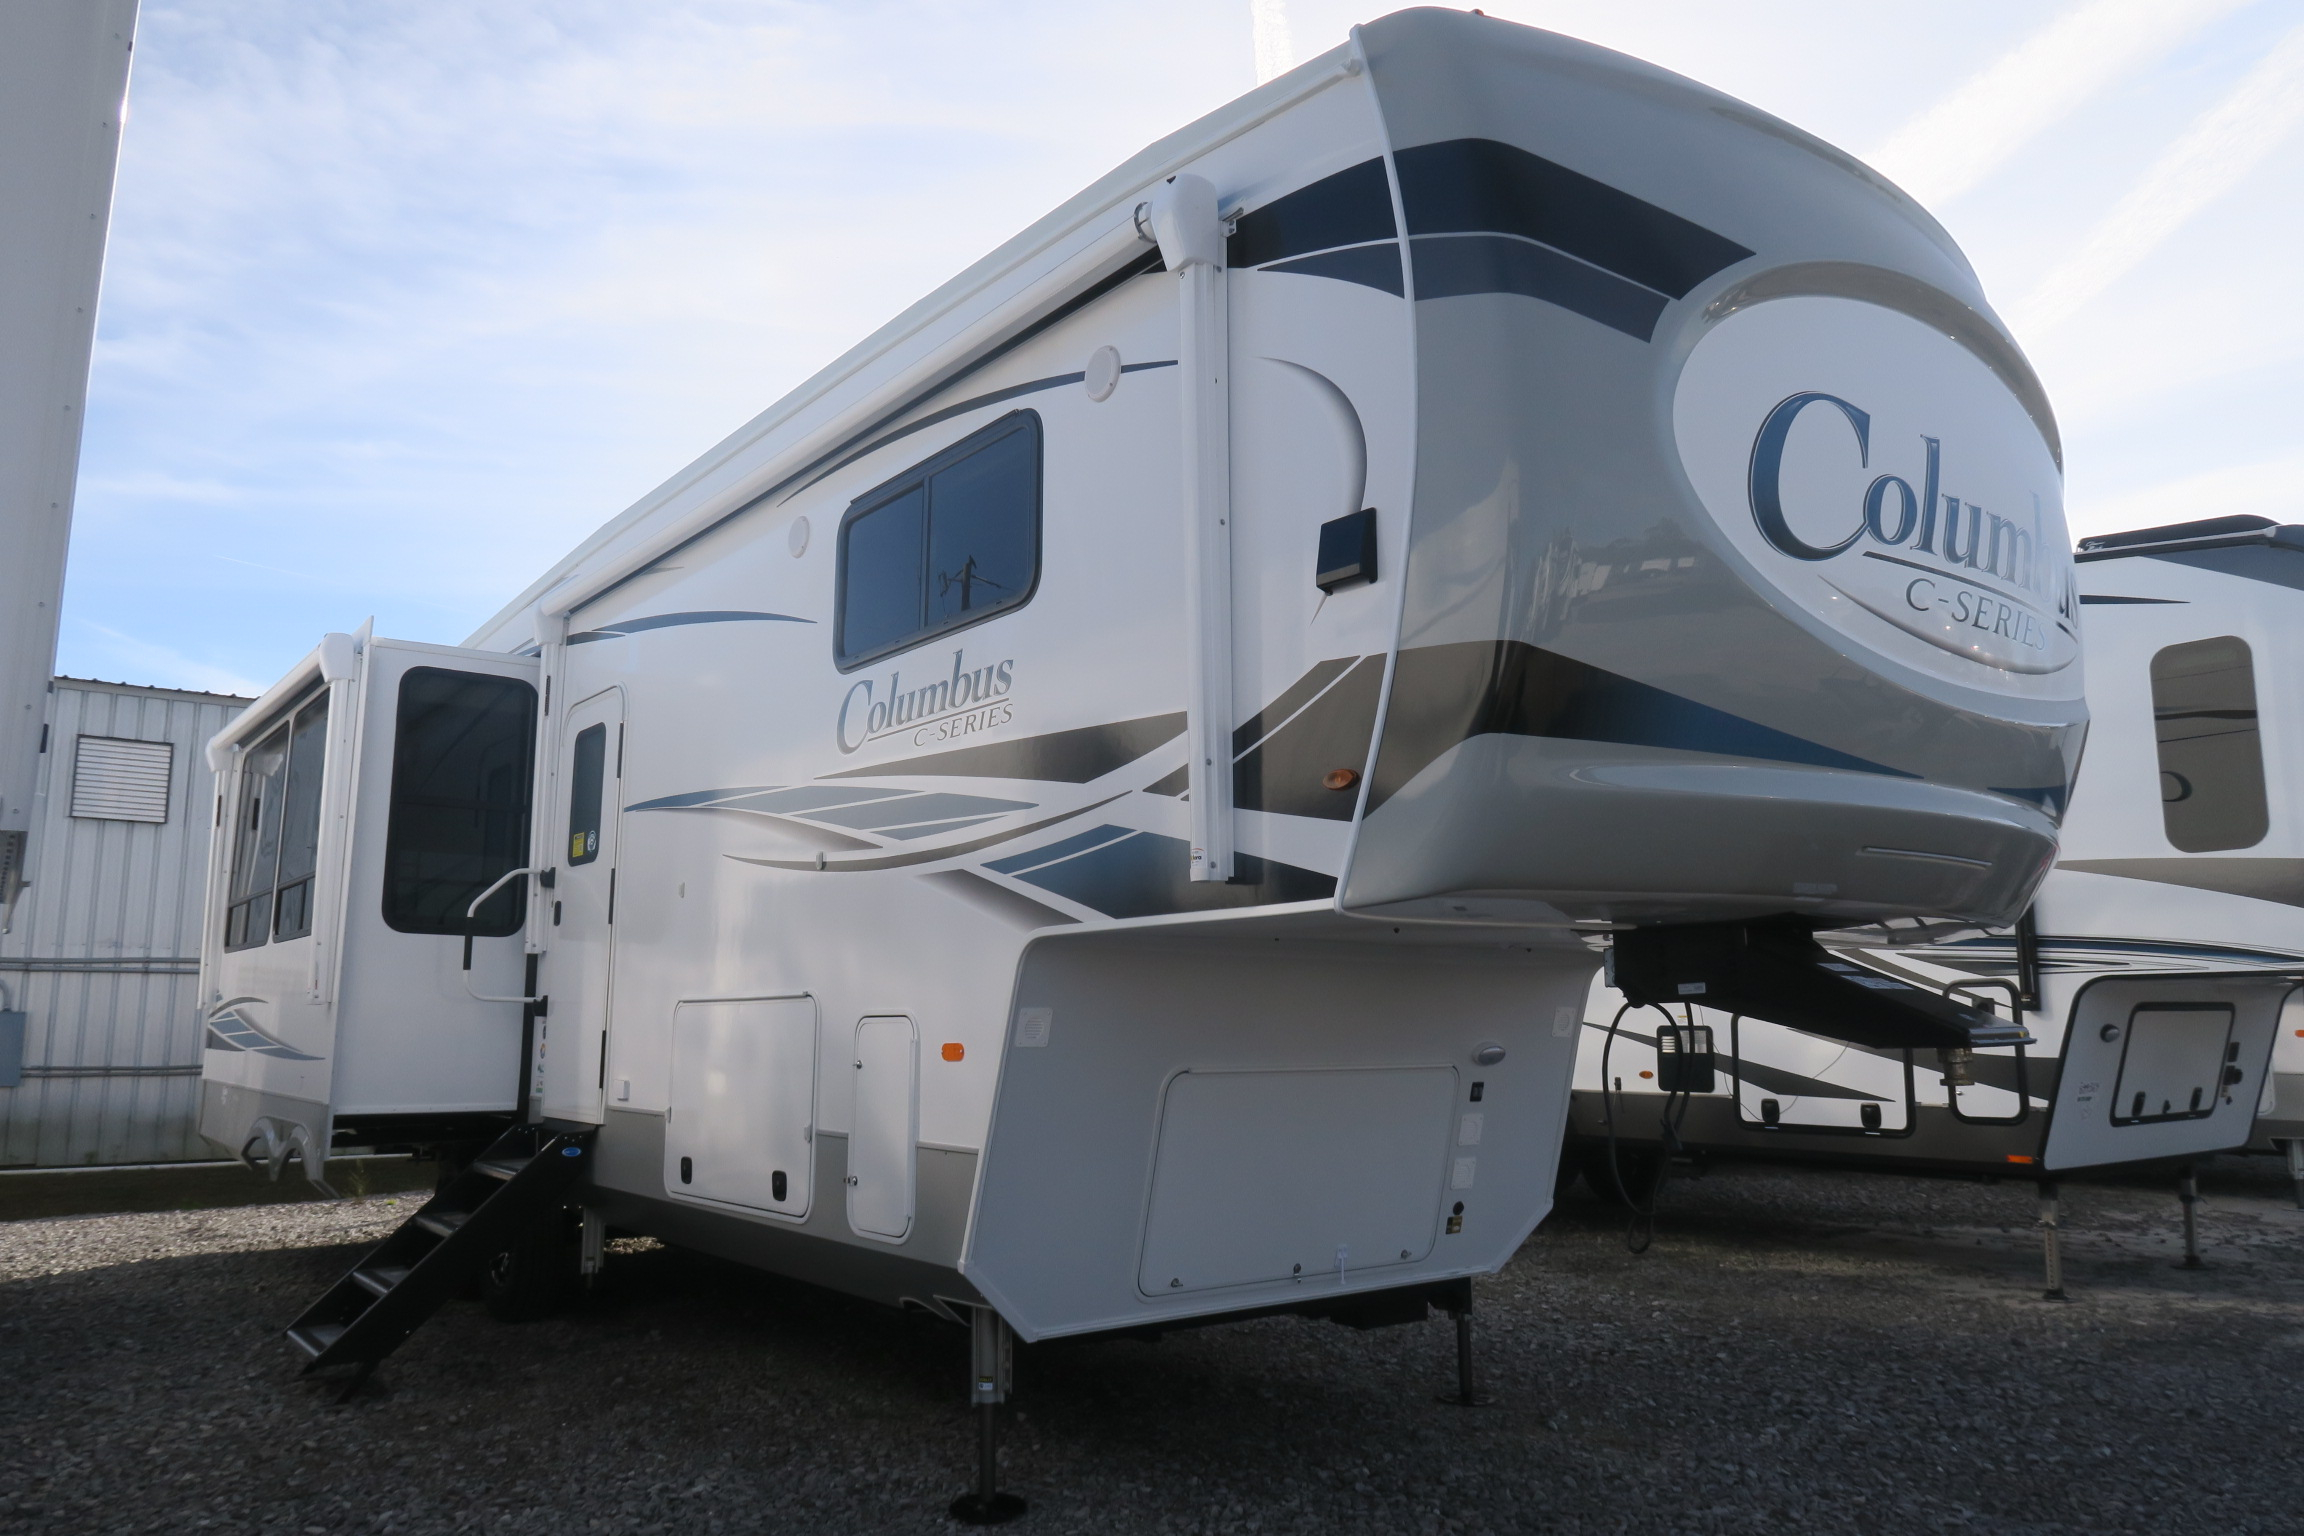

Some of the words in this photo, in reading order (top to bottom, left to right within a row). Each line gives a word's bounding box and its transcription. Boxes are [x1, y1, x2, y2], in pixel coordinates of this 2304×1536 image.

[1905, 578, 2046, 651] C-SERIES
[837, 648, 1014, 755] Columbus
[913, 703, 1013, 747] C-SERIES
